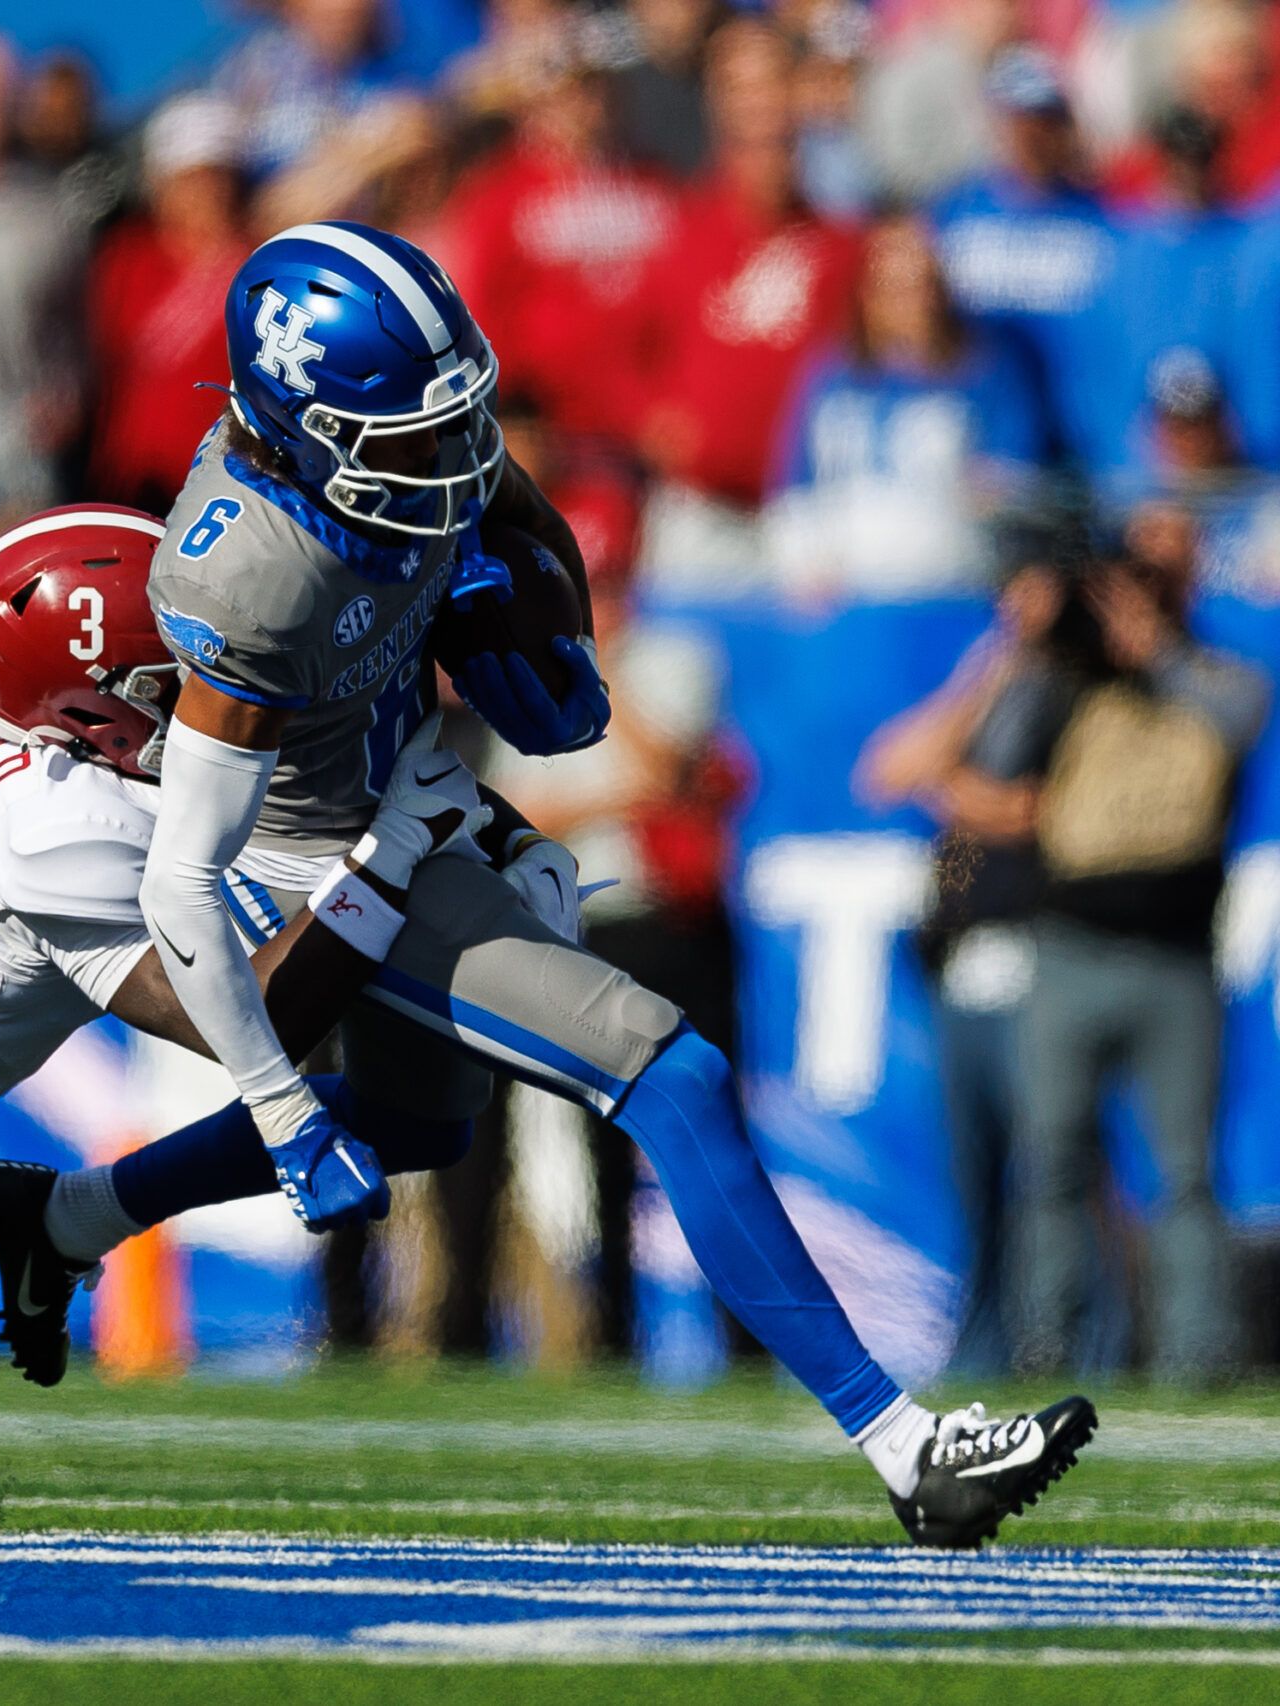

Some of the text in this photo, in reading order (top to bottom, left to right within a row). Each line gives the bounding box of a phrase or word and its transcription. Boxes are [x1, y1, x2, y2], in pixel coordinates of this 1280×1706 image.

[254, 286, 326, 395] UK
[177, 496, 245, 561] 6
[68, 587, 104, 660] 3
[337, 600, 372, 643] SEC
